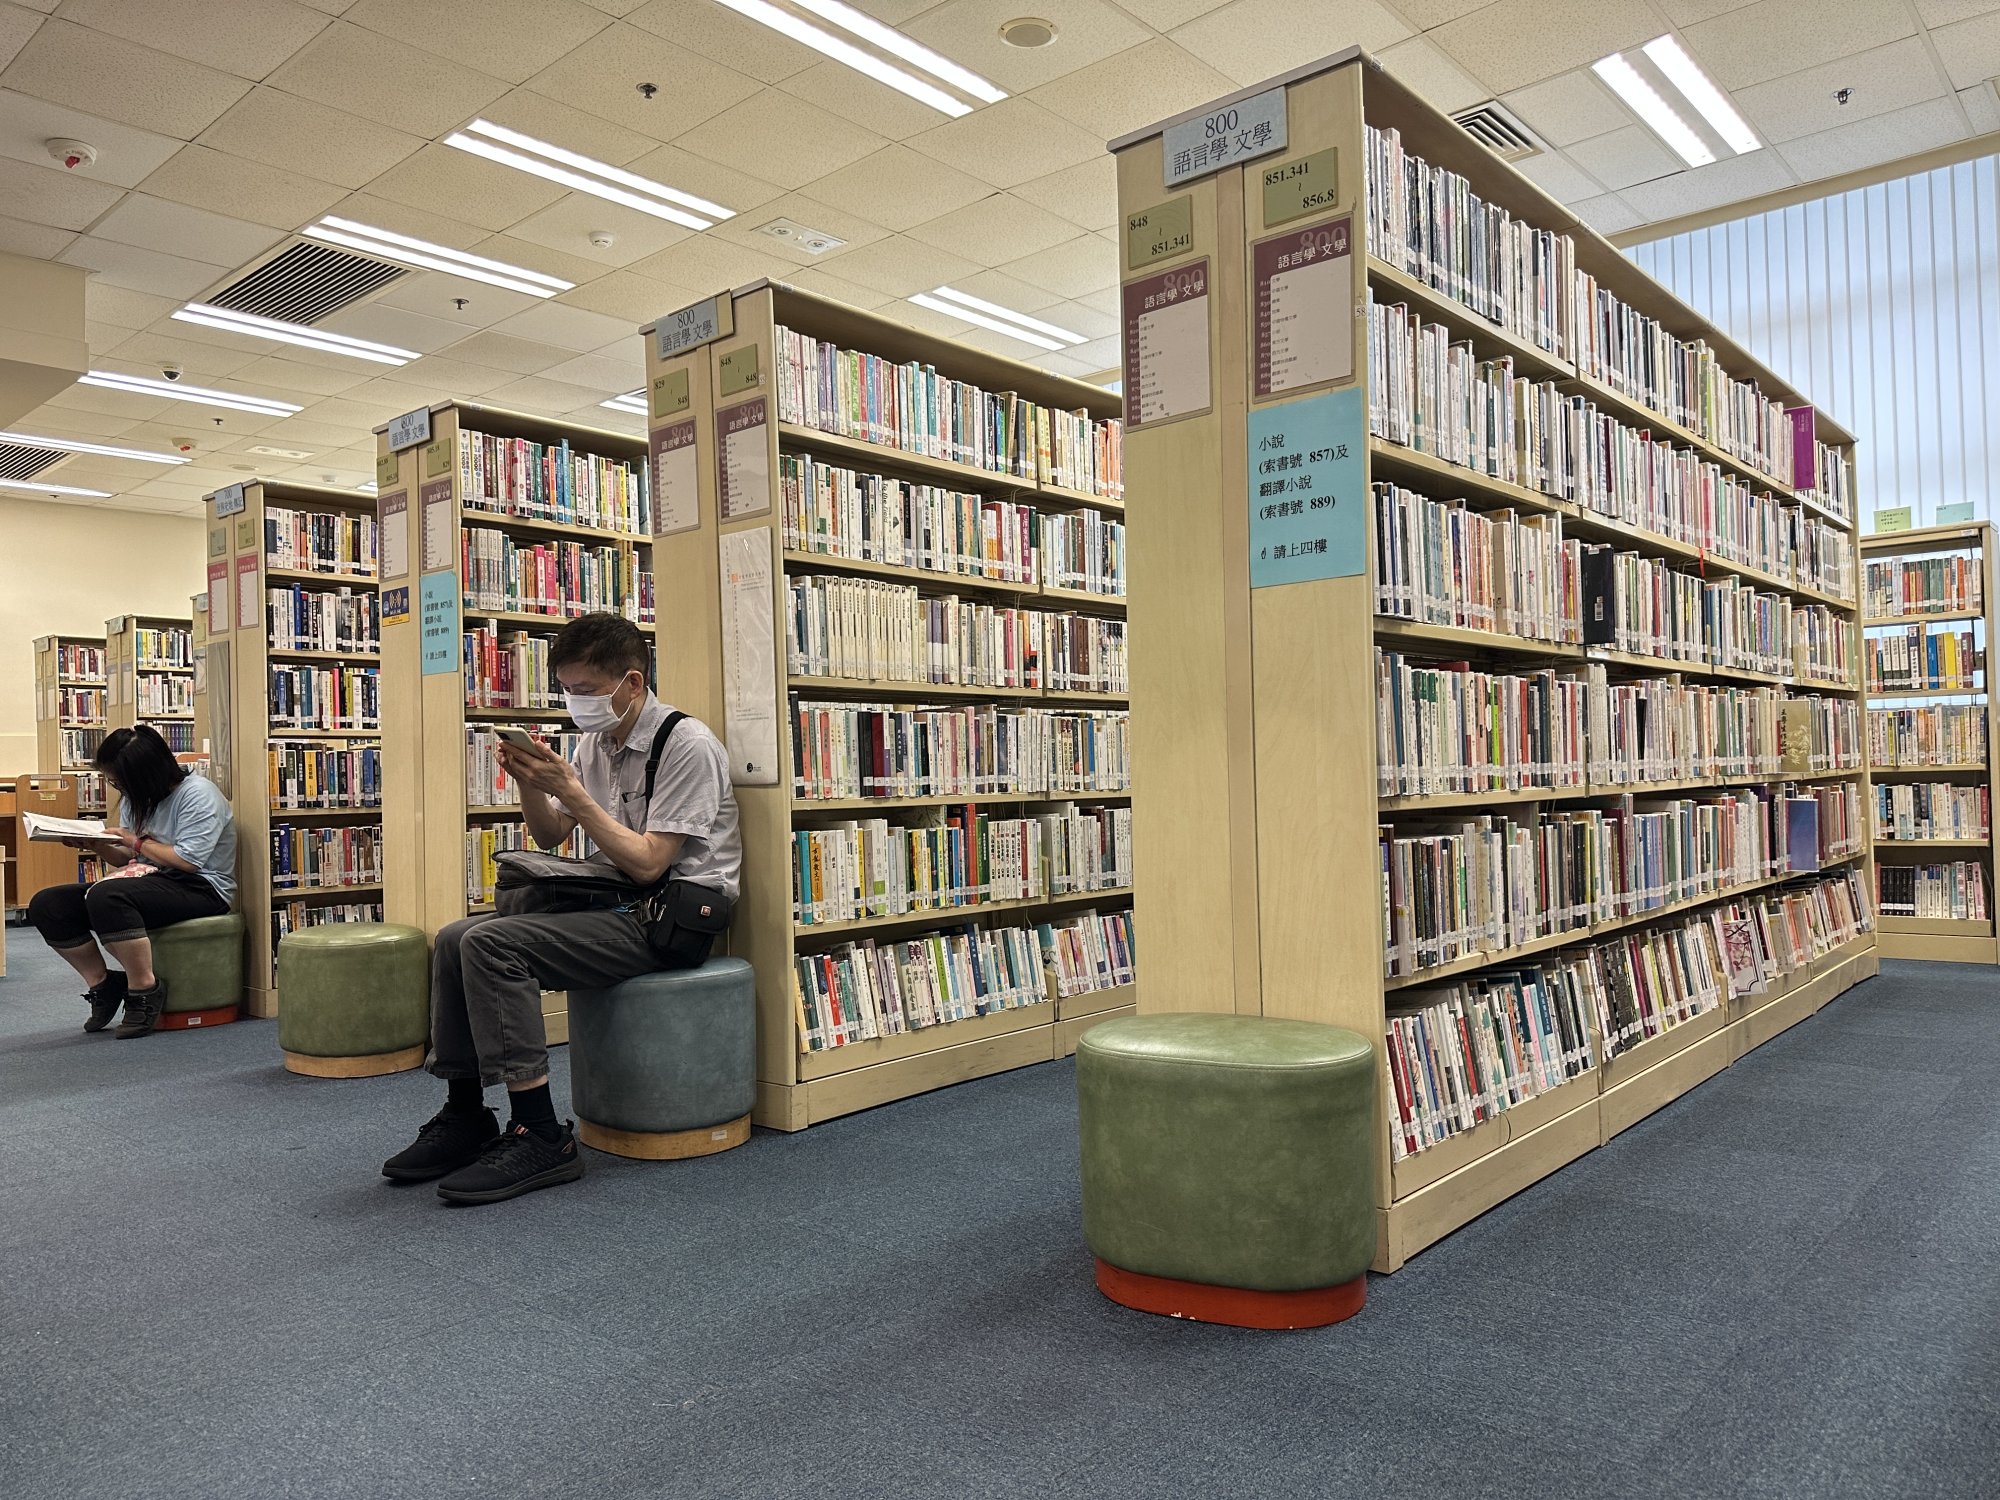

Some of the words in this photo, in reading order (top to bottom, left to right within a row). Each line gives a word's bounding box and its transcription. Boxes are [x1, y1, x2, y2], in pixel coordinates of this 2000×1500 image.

[1205, 110, 1239, 138] 800
[1173, 136, 1228, 176] 語言學
[1233, 121, 1272, 155] 文學
[1265, 162, 1309, 186] 851.341
[1302, 189, 1335, 208] 856.8
[1130, 215, 1148, 231] 848
[1151, 233, 1190, 256] 851.341
[1300, 227, 1347, 254] 800
[1277, 246, 1316, 269] 語言學
[1321, 238, 1347, 257] 文學
[1144, 288, 1178, 309] 語言學
[1182, 279, 1204, 297] 文學
[1163, 269, 1204, 295] 800
[677, 309, 695, 329] 800
[662, 328, 691, 353] 語言學
[693, 320, 712, 342] 文學
[729, 417, 749, 431] 語言學
[751, 412, 764, 424] 文學
[740, 404, 763, 419] 800
[391, 428, 411, 447] 語言學
[412, 423, 425, 441] 文學
[661, 437, 680, 451] 語言學
[681, 432, 694, 444] 文學
[1258, 434, 1285, 452] 小說
[1258, 453, 1303, 475] (索書號
[1309, 444, 1350, 464] 857)及
[1259, 474, 1312, 497] 翻譯小說
[1259, 499, 1304, 521] (索書號
[1310, 495, 1336, 511] 889)
[1273, 538, 1328, 560] 請上四樓
